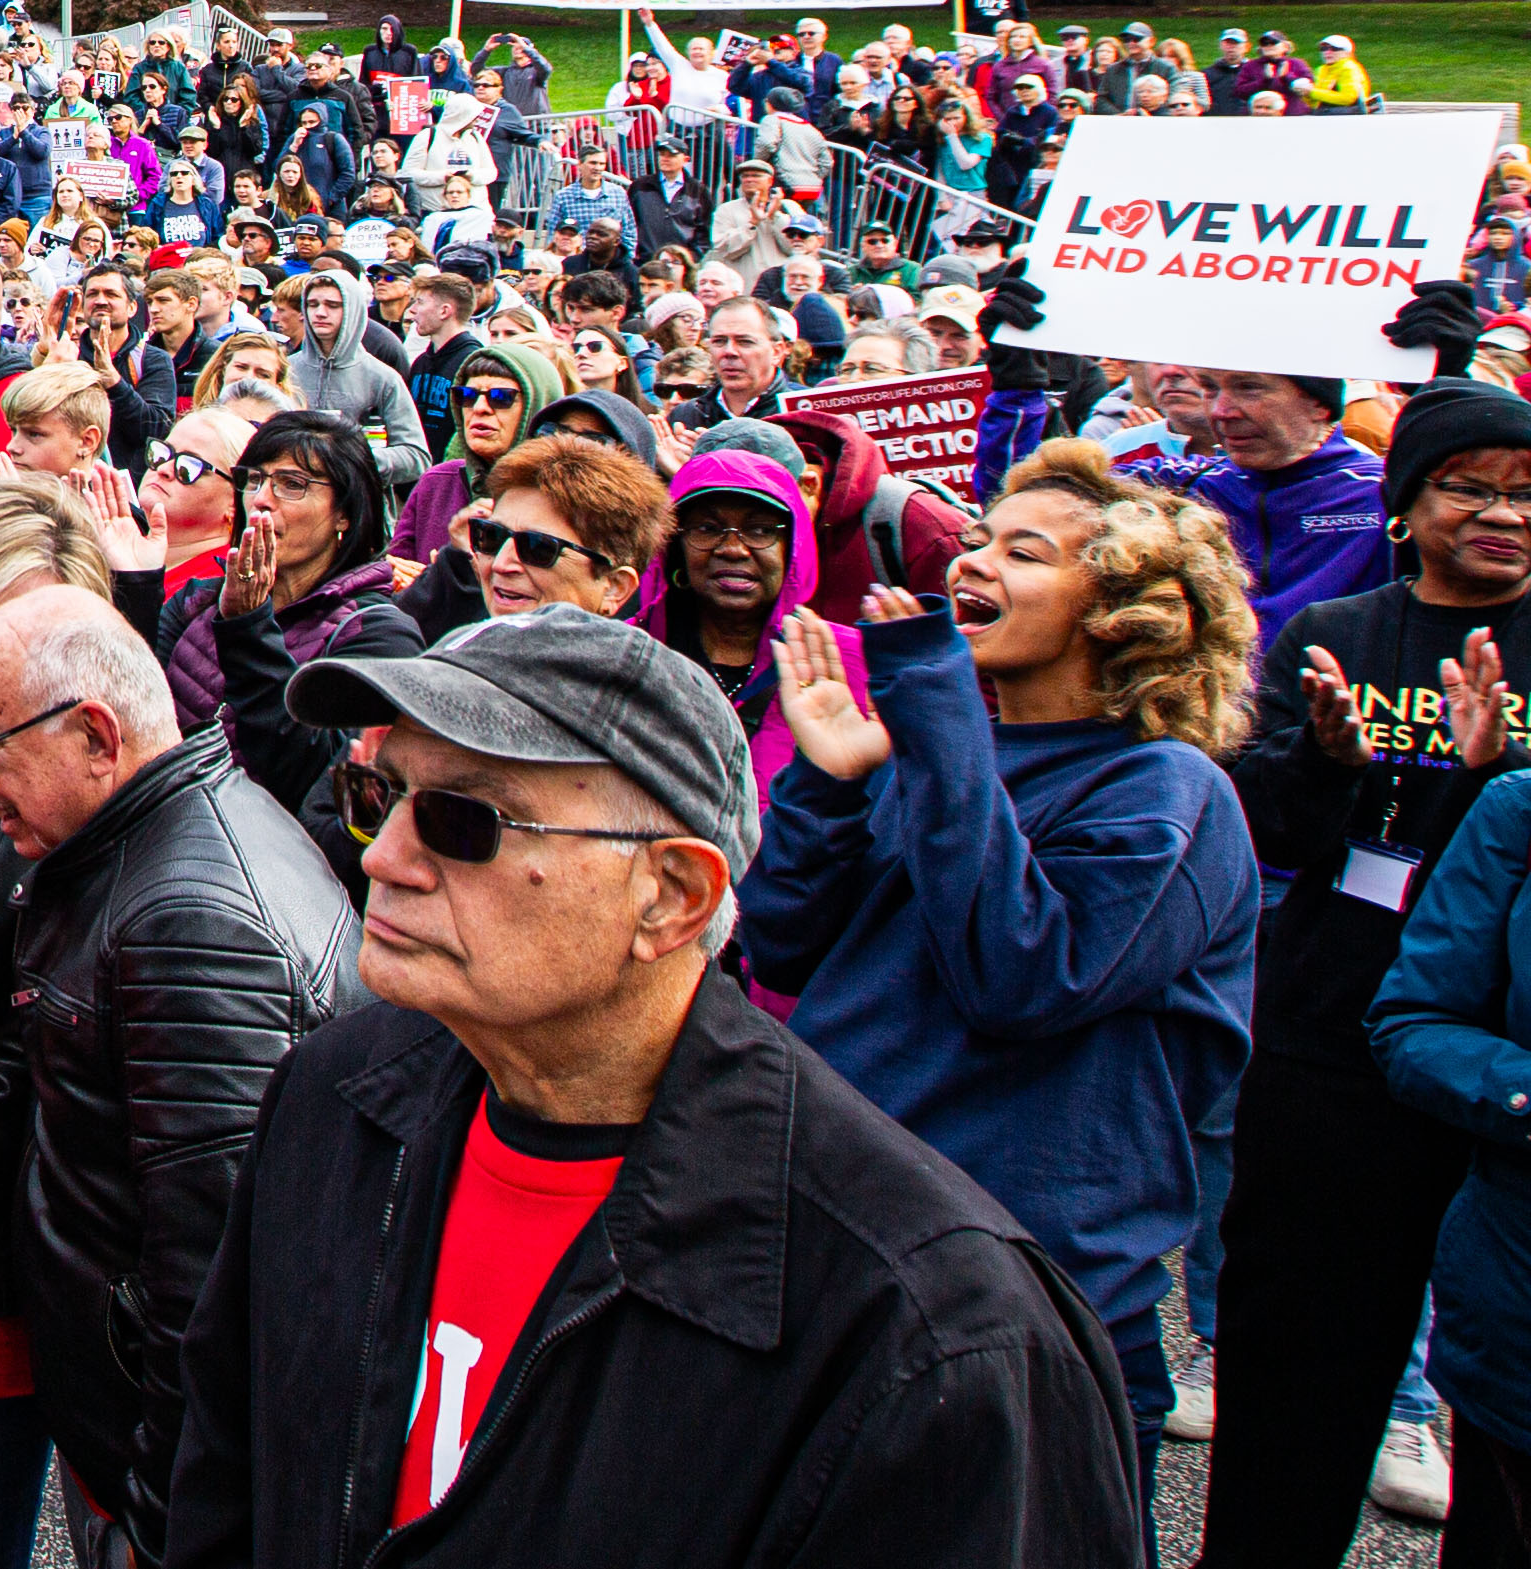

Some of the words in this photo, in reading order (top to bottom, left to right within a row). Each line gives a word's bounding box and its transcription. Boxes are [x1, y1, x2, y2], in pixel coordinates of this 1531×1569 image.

[400, 85, 408, 110] THEM
[409, 95, 418, 122] BOTH
[400, 111, 408, 131] LOVE
[164, 214, 199, 225] PROUD
[358, 224, 382, 232] PRAY
[1252, 203, 1429, 249] WILL
[165, 231, 201, 242] FETUS
[342, 241, 388, 249] ABORTIO
[1053, 244, 1147, 274] END
[1157, 252, 1422, 287] ABORTION
[814, 378, 984, 410] STUDENTSFORLIFEACTION.ORG
[875, 428, 978, 462] TECTIO
[1301, 515, 1381, 528] SCRANTON
[1350, 683, 1531, 728] NBR
